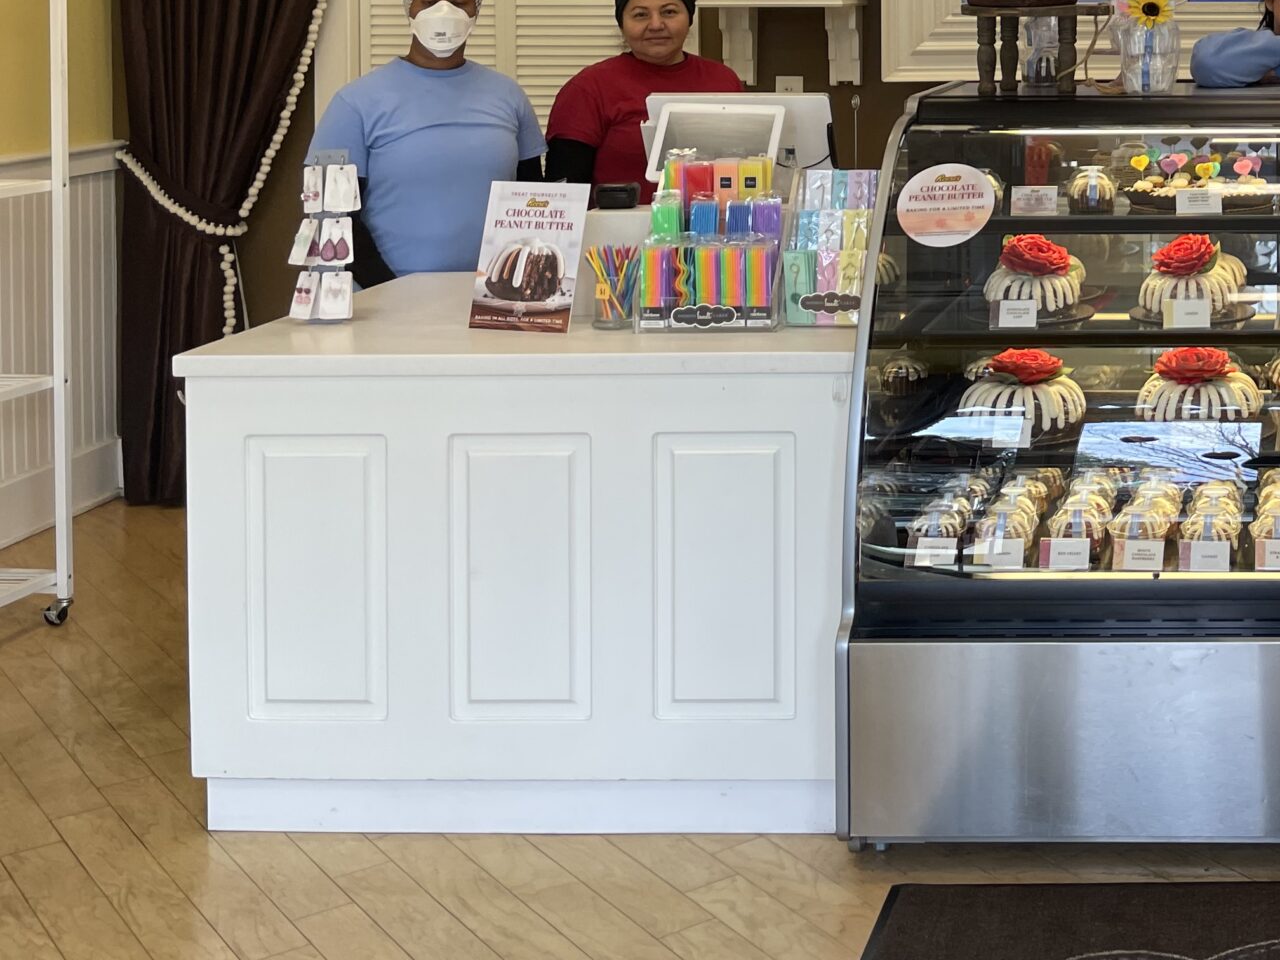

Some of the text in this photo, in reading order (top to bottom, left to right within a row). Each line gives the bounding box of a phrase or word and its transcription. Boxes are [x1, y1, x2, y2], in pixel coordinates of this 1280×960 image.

[920, 183, 978, 193] CHOCOLATE
[908, 191, 985, 202] PEANUT BUTTER
[505, 208, 566, 219] CHOCOLATE
[494, 219, 574, 231] PEANUT BUTTER
